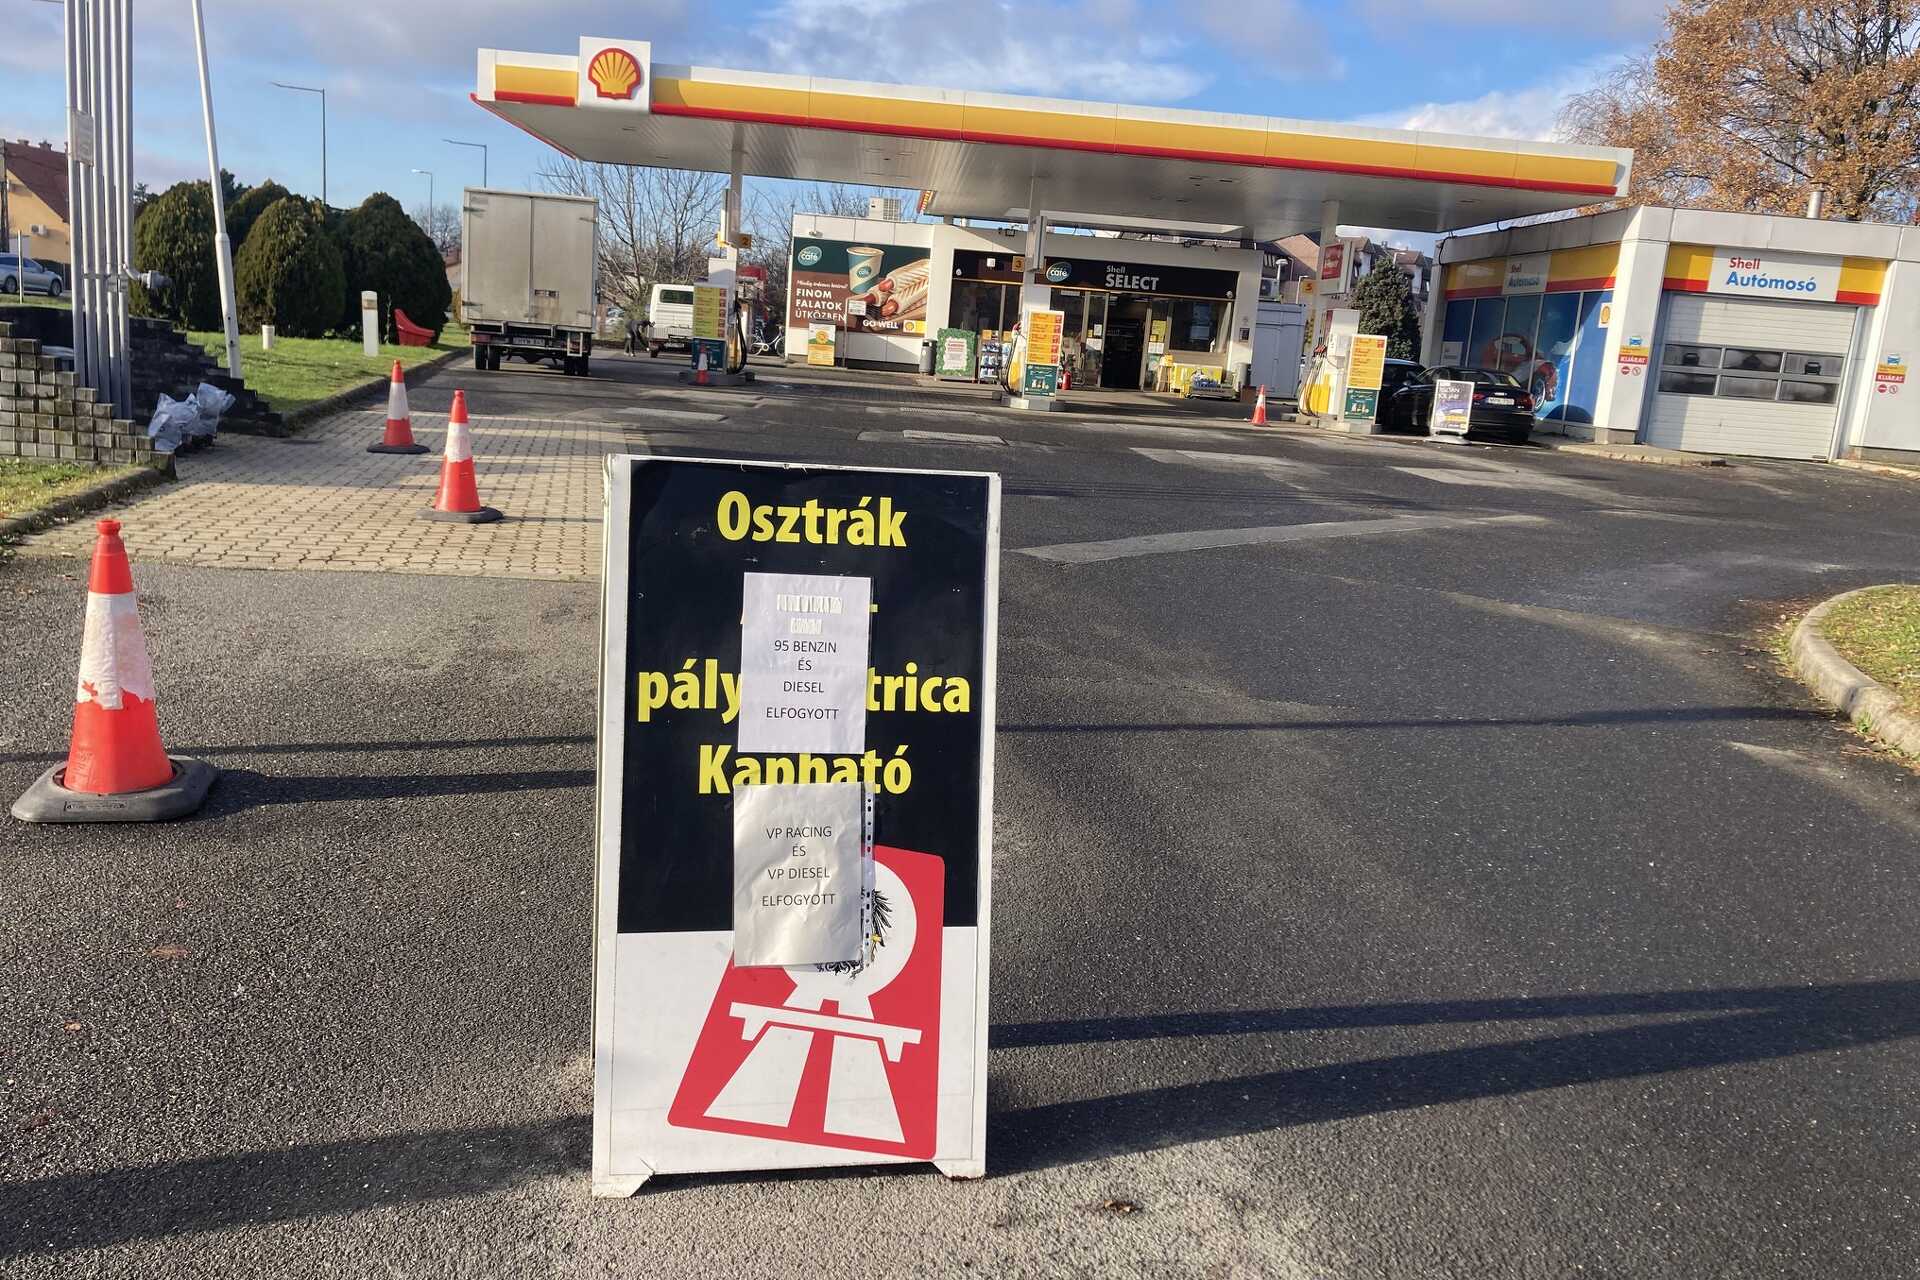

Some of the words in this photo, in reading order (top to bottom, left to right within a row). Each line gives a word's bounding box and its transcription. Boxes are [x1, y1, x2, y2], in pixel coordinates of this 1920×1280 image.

[1106, 265, 1126, 274] Shell
[1730, 257, 1761, 270] Shell
[1105, 273, 1160, 291] SELECT
[1726, 271, 1817, 292] Autómosó
[796, 288, 832, 299] FINOM
[796, 298, 843, 311] FALATOK
[863, 319, 876, 328] GO
[879, 320, 899, 329] WELL
[717, 490, 907, 547] Osztrák
[774, 639, 789, 652] 95
[793, 640, 837, 653] BENZIN
[798, 657, 812, 671] ÉS
[783, 681, 825, 694] DIESEL
[766, 706, 839, 720] ELFOGYOTT
[766, 827, 783, 839] VP
[786, 825, 832, 839] RACING
[792, 843, 807, 857] ÉS
[767, 868, 784, 880] VP
[788, 866, 830, 880] DIESEL
[762, 893, 836, 907] ELFOGYOTT
